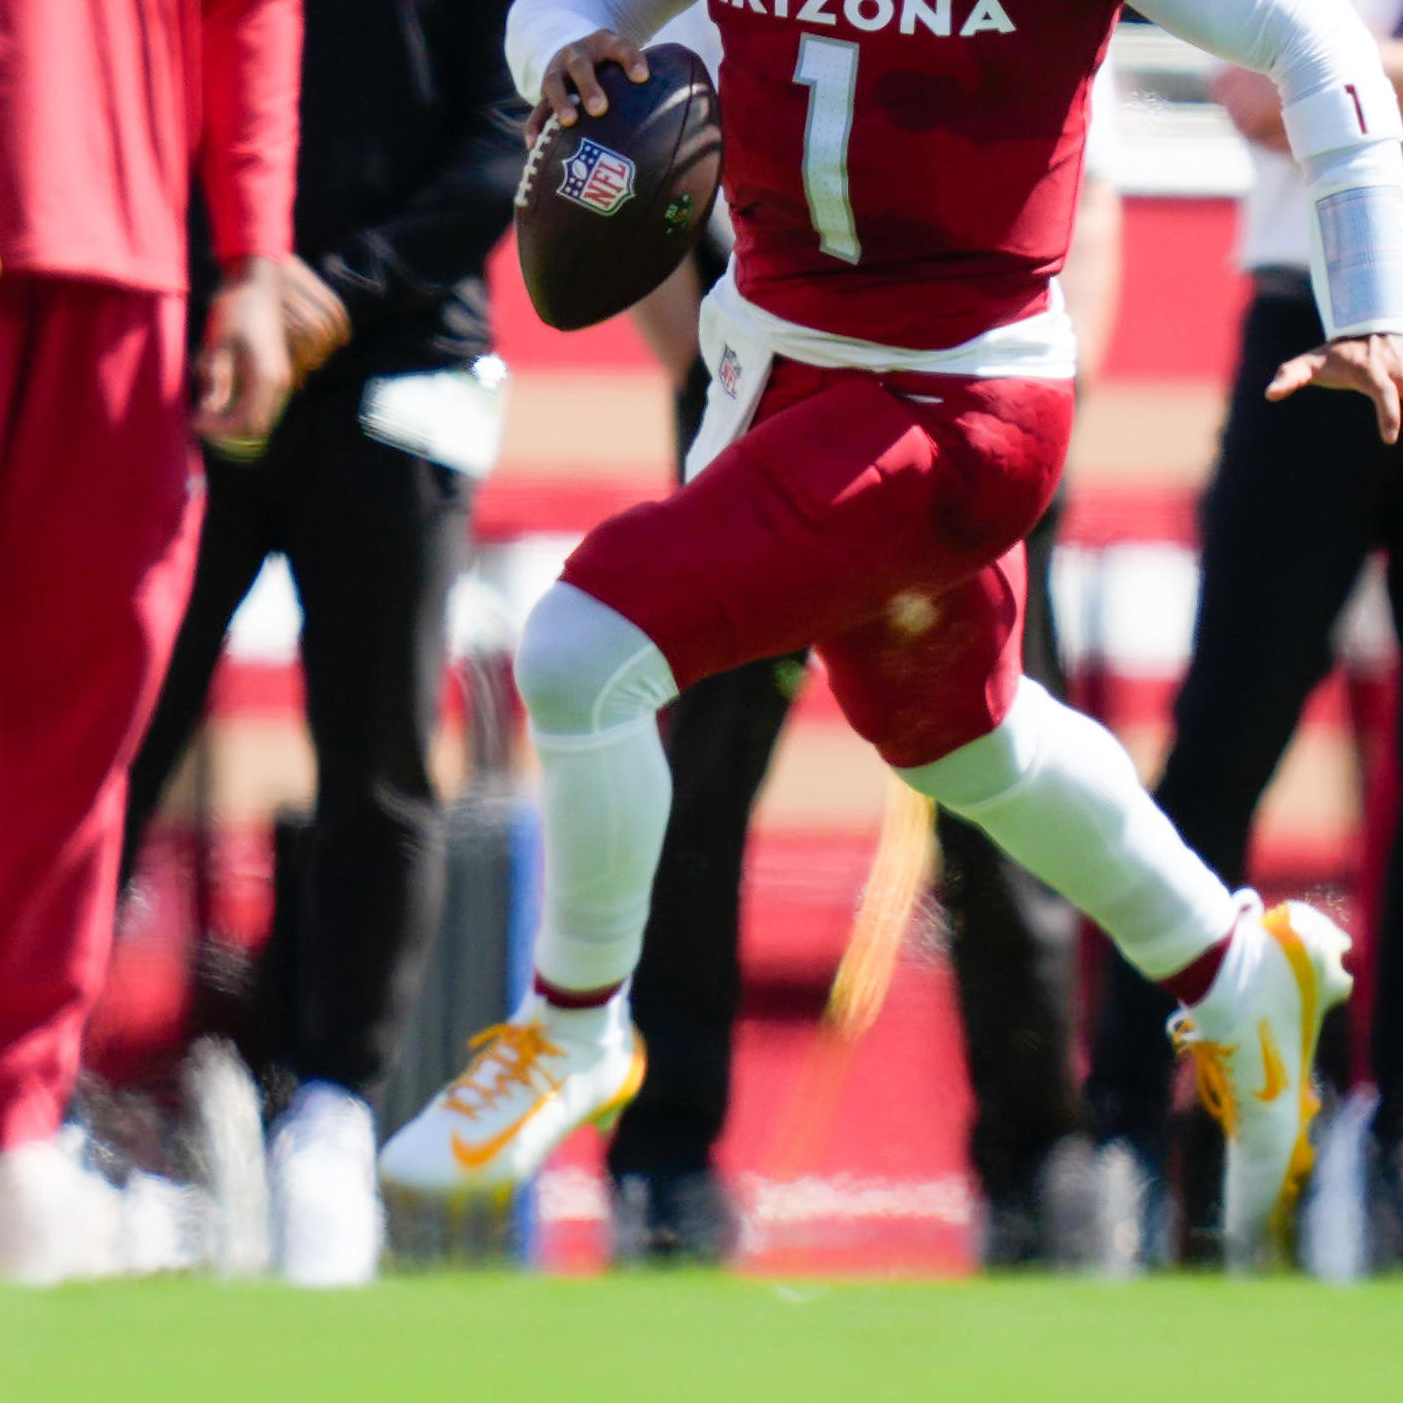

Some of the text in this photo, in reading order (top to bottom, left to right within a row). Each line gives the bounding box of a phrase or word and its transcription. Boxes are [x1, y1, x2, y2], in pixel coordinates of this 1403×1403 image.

[1344, 84, 1369, 136] 1
[792, 31, 863, 266] 1
[584, 161, 626, 208] NFL
